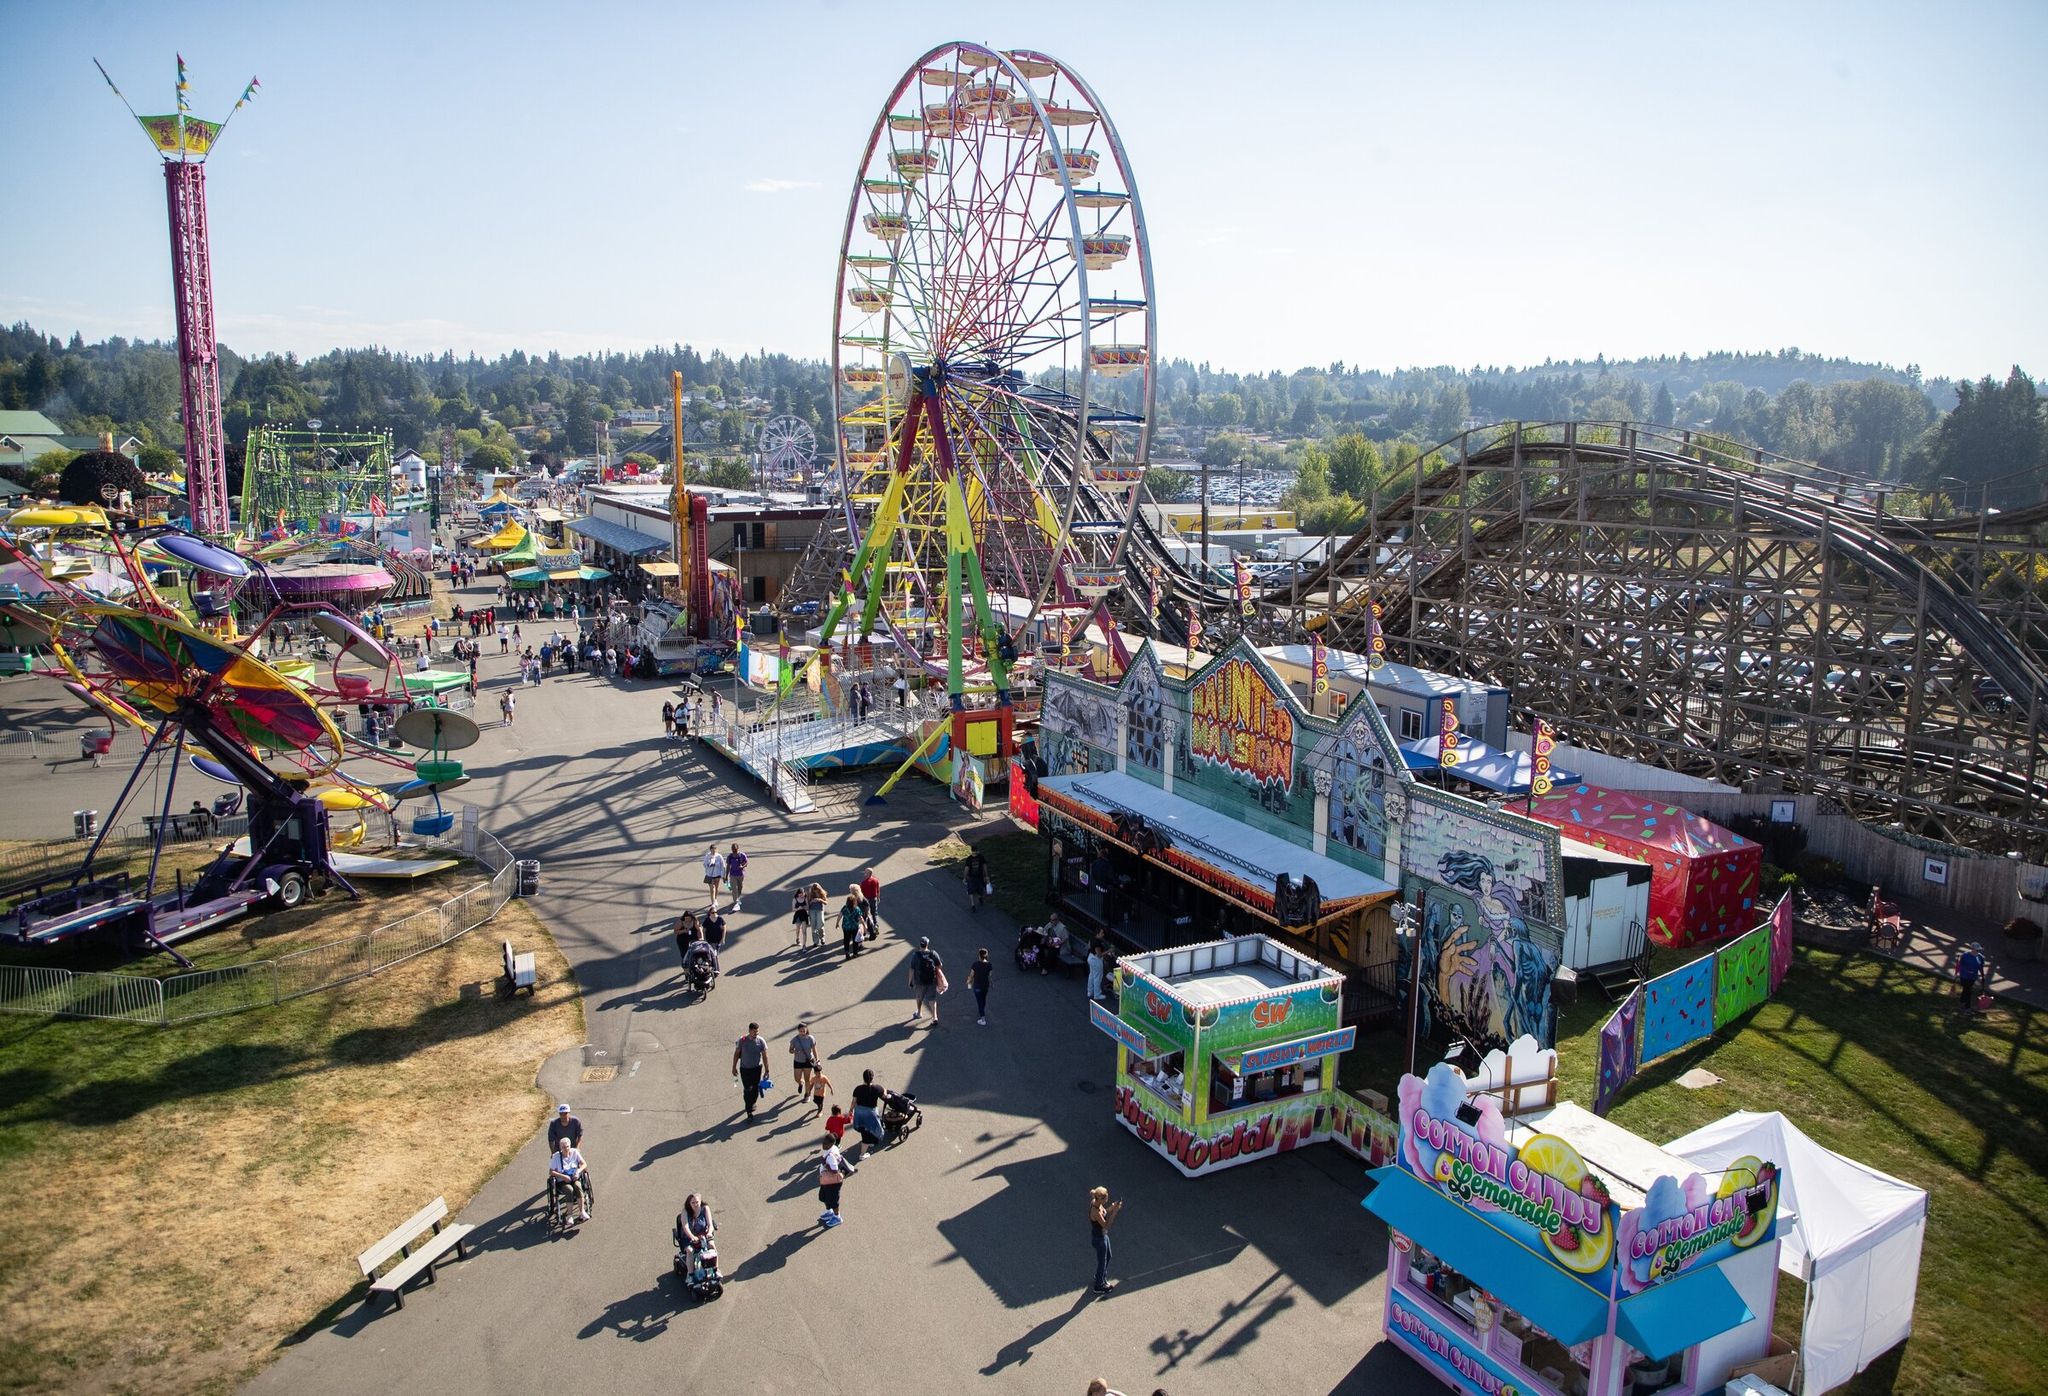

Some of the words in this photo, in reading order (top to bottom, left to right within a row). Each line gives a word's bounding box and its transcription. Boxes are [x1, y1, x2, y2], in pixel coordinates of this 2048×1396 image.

[1192, 657, 1292, 742] HAUNTED
[1192, 716, 1292, 787] MANSION
[1146, 991, 1173, 1023] SW
[1254, 996, 1293, 1028] SW
[1246, 1045, 1297, 1068] SLUSHY
[1307, 1032, 1350, 1054] WORLD
[1164, 1112, 1273, 1170] World
[1413, 1108, 1509, 1183] COTTON
[1508, 1159, 1602, 1234] CANDY
[1447, 1158, 1562, 1235] Lemonade
[1631, 1204, 1709, 1259] COTTON
[1661, 1206, 1745, 1277] Lemonade
[1391, 1302, 1450, 1360] COTTON
